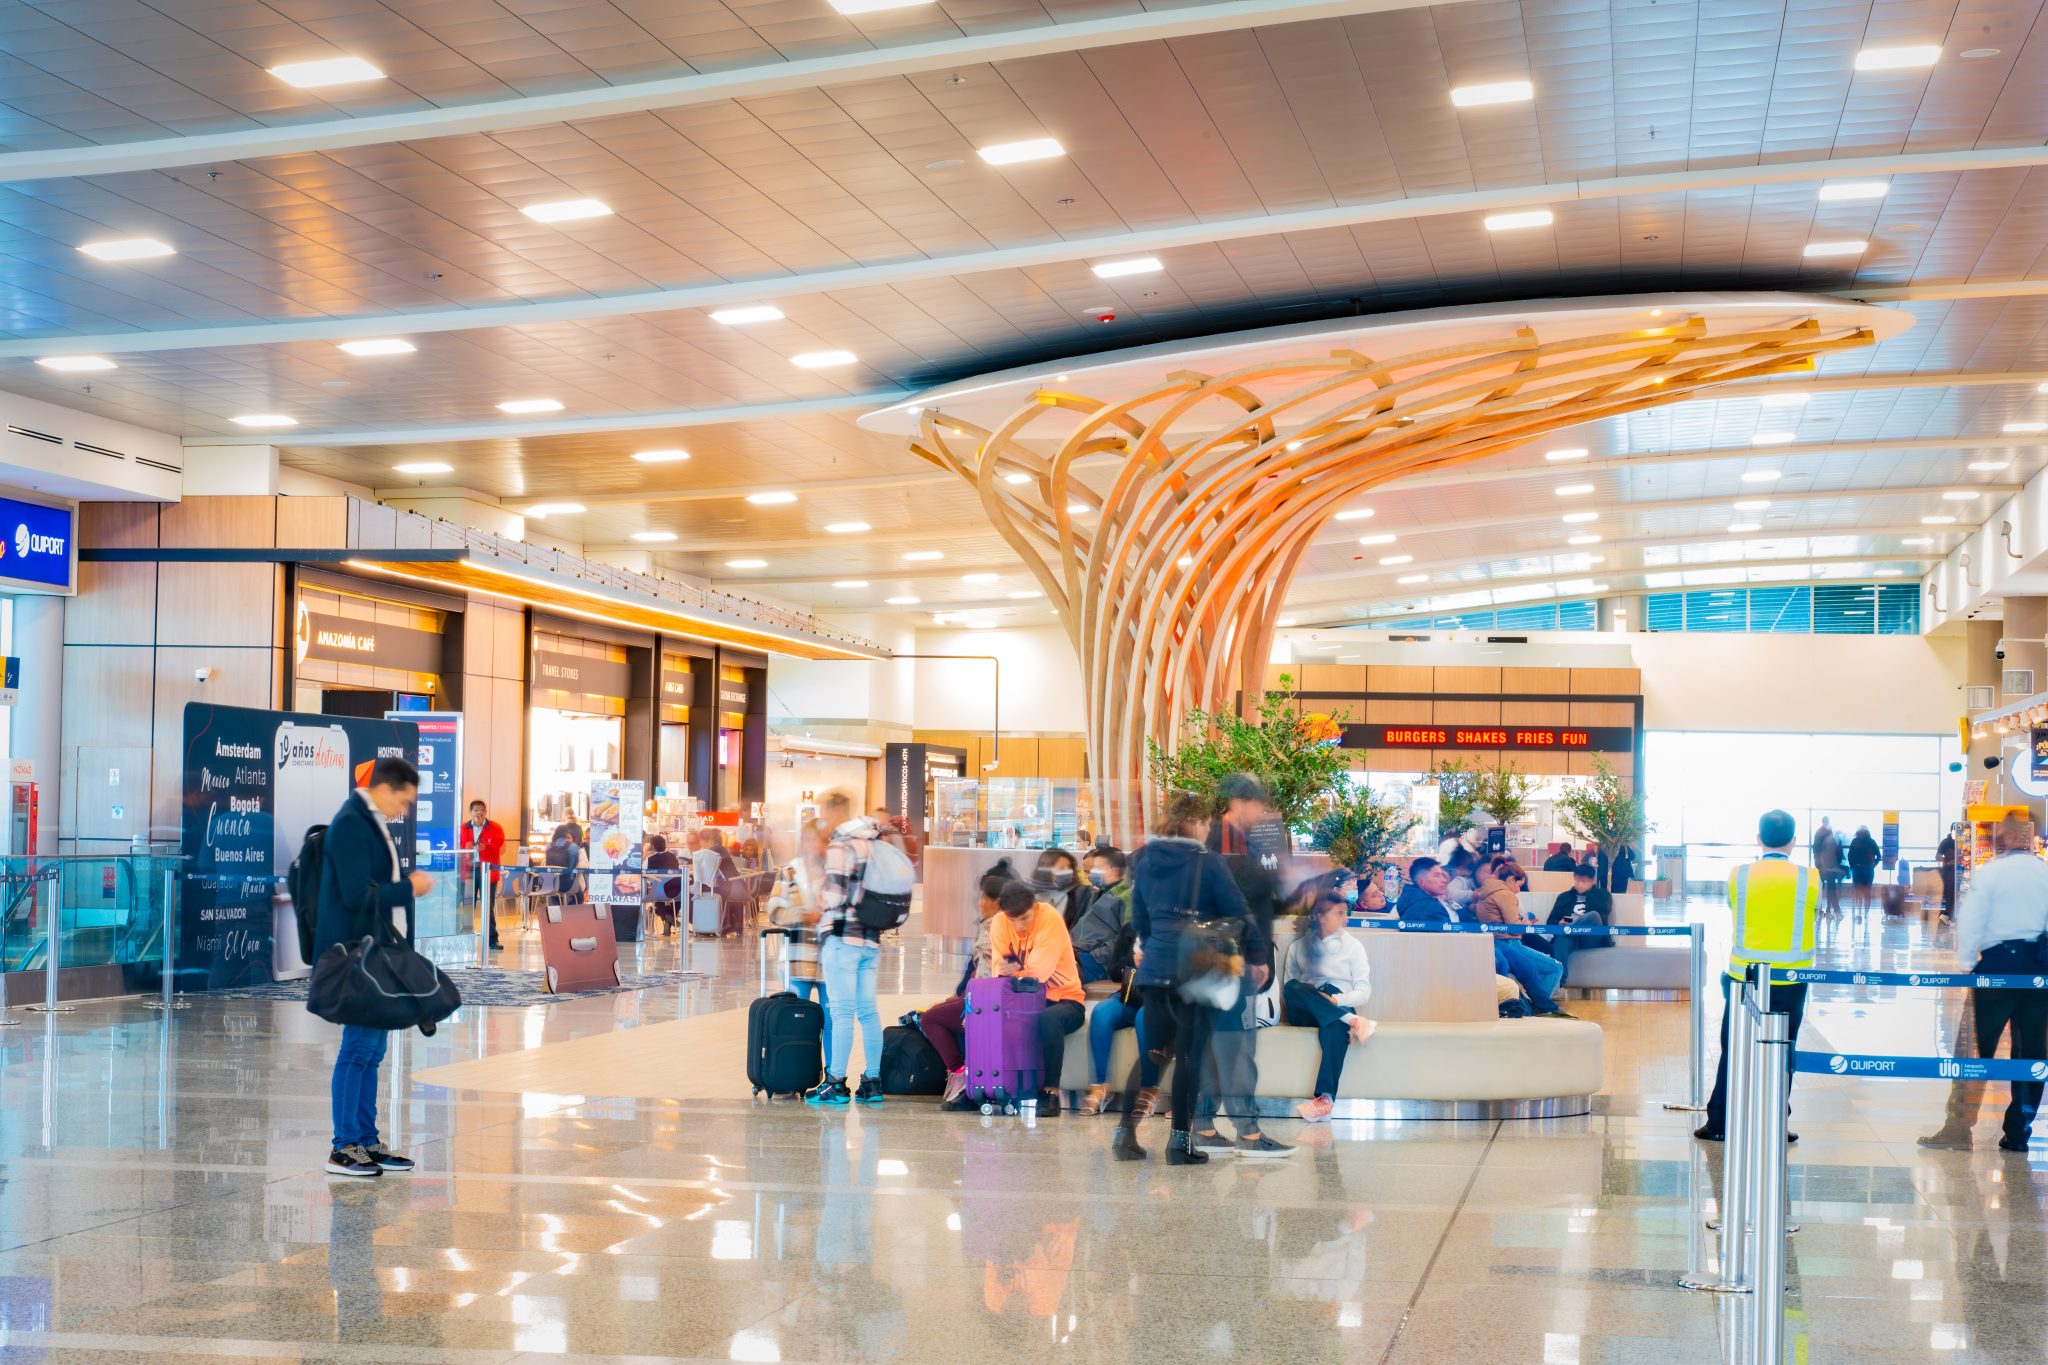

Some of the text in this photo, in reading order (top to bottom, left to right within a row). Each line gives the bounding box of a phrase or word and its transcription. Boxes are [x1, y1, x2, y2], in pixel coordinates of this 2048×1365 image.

[31, 533, 65, 556] QUIPORT
[317, 631, 375, 652] AMAZONÍA CAFÉ
[542, 664, 579, 680] TRAVEL STORES
[1386, 730, 1588, 745] BURGERS SHAKES FRIES FUN
[215, 737, 262, 759] Ámsterdam
[292, 741, 315, 759] años
[377, 747, 404, 759] HOUSTON
[901, 748, 909, 762] ATM
[234, 766, 267, 786] Atlanta
[230, 796, 260, 816] Bogotá
[206, 801, 252, 847] Cuenca
[215, 847, 265, 862] Buenos Aires
[588, 895, 641, 903] BREAKFAST
[201, 908, 247, 921] SAN SALVADOR
[196, 935, 222, 953] Miami
[1799, 973, 1827, 981] QUIPORT
[1921, 977, 1950, 985] QUIPORT
[1850, 1060, 1896, 1071] QUIPORT
